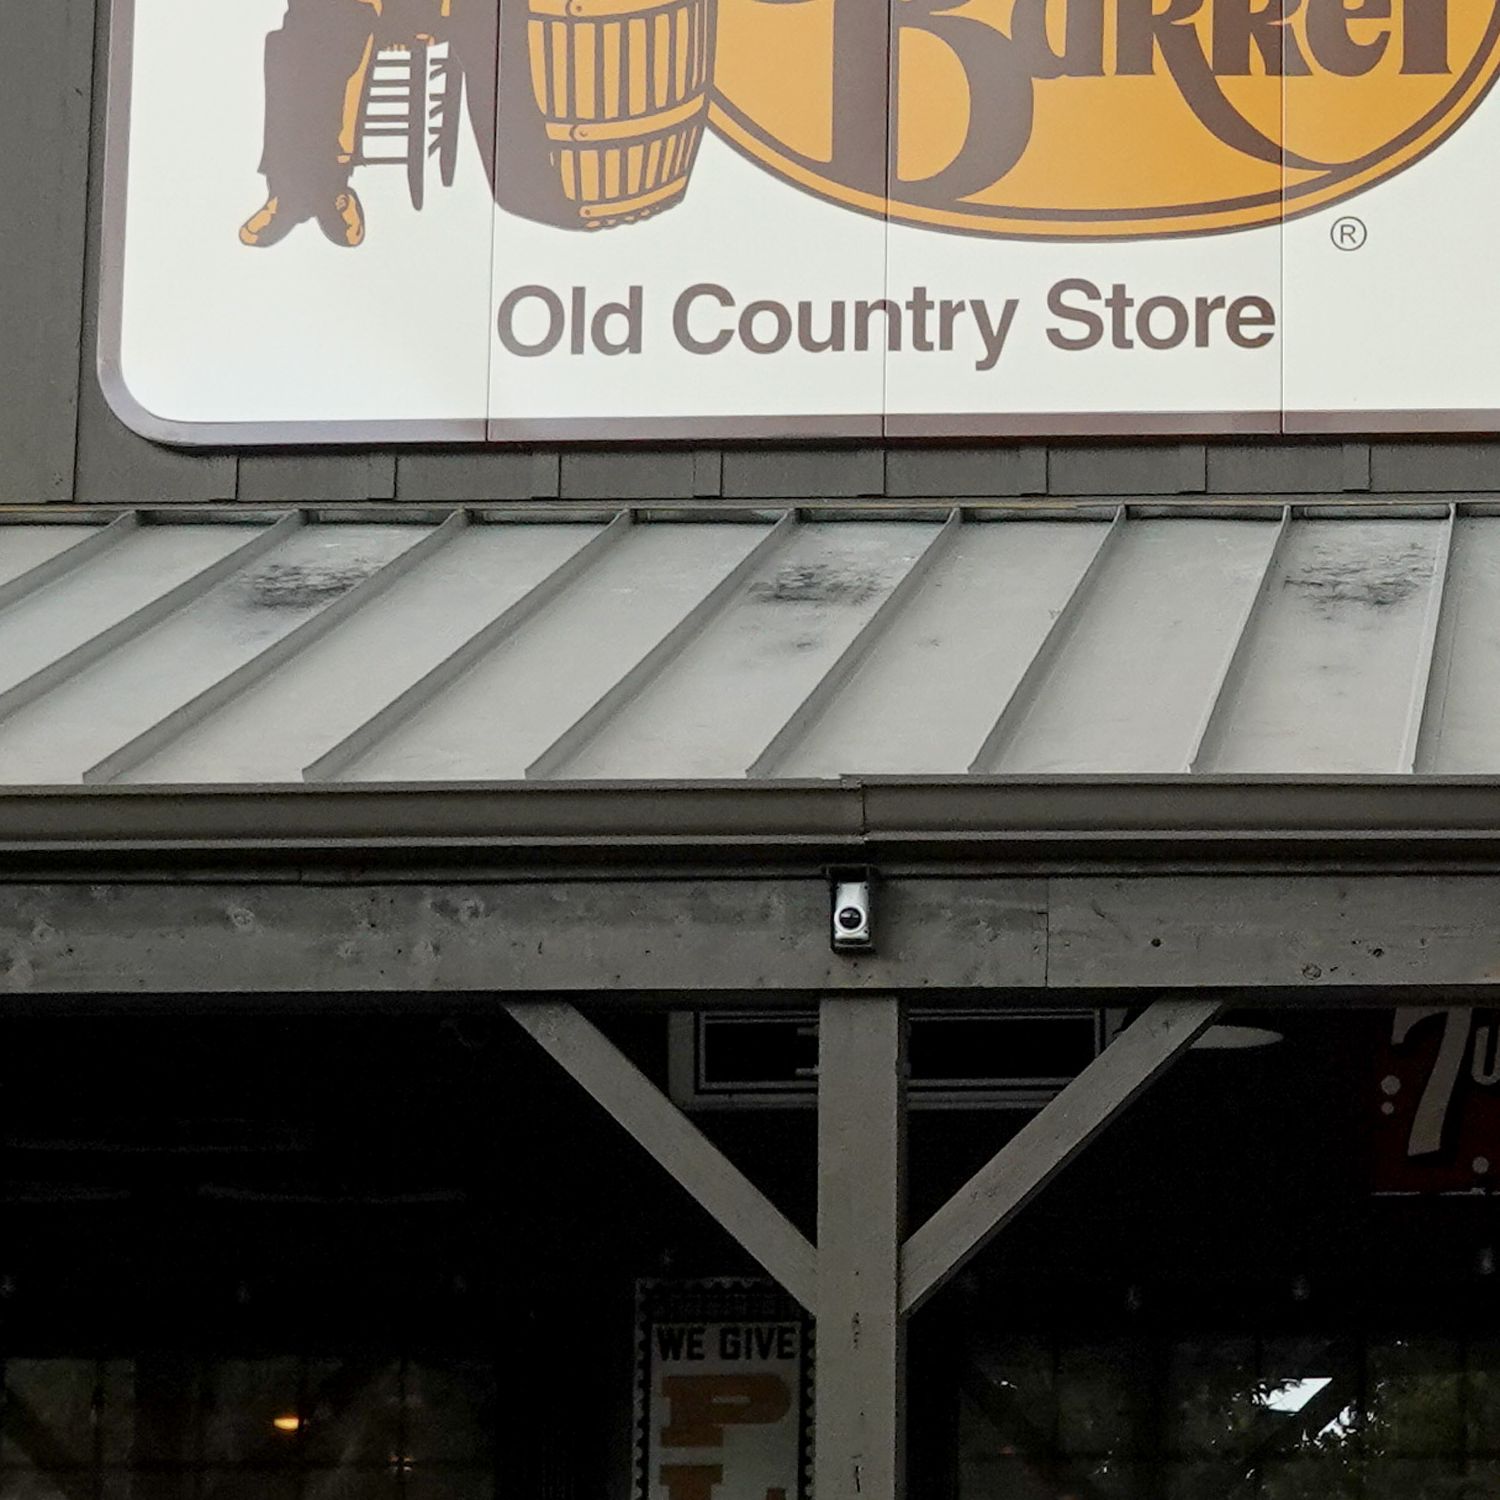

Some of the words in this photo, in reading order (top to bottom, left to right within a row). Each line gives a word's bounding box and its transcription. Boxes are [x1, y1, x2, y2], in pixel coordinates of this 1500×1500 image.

[497, 283, 642, 357] Old
[673, 282, 1019, 371] Country
[1045, 278, 1276, 351] Store
[657, 1326, 704, 1360] WE
[720, 1326, 796, 1360] GIVE
